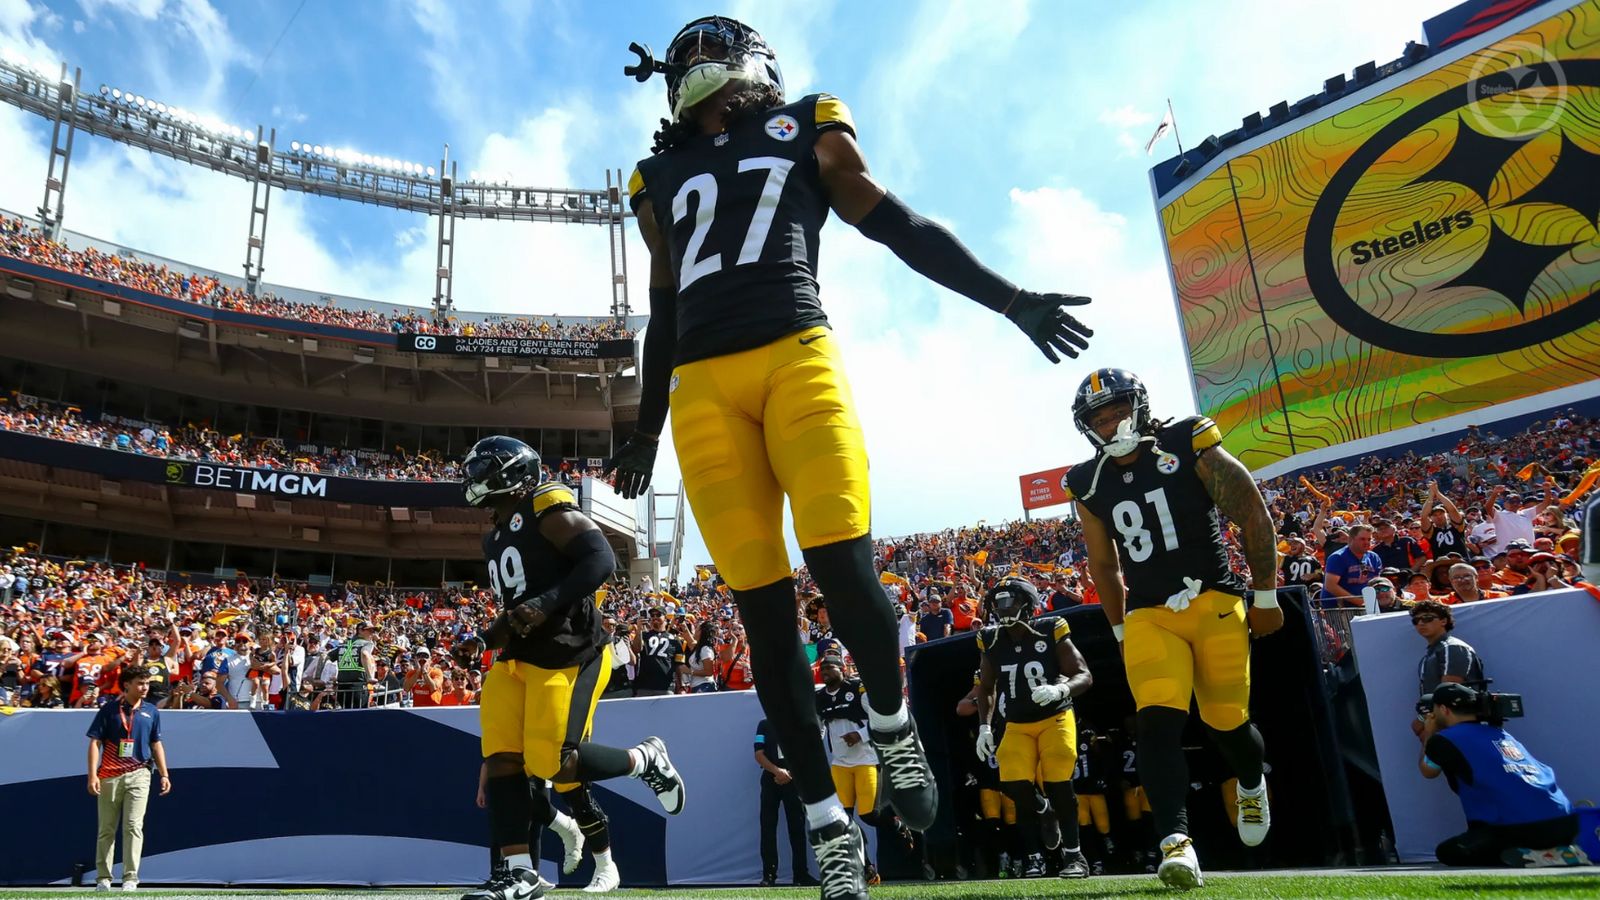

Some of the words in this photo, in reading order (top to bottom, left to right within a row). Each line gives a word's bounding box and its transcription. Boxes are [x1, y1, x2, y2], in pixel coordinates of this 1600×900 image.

[672, 156, 796, 294] 27
[1350, 208, 1475, 266] Steelers
[416, 337, 434, 349] CC
[455, 344, 479, 352] ONLY
[480, 345, 494, 353] 724
[497, 346, 519, 354] FEET
[520, 347, 549, 355] ABOVE
[550, 348, 568, 356] SEA
[468, 338, 498, 346] LADIES
[500, 339, 518, 347] AND
[520, 340, 572, 349] GENTLEMEN
[574, 341, 599, 350] FROM
[194, 465, 328, 498] BETMGM
[1112, 487, 1180, 563] 81
[1436, 530, 1455, 548] 90
[1289, 561, 1311, 581] 90
[648, 636, 670, 657] 92
[1000, 660, 1048, 699] 78
